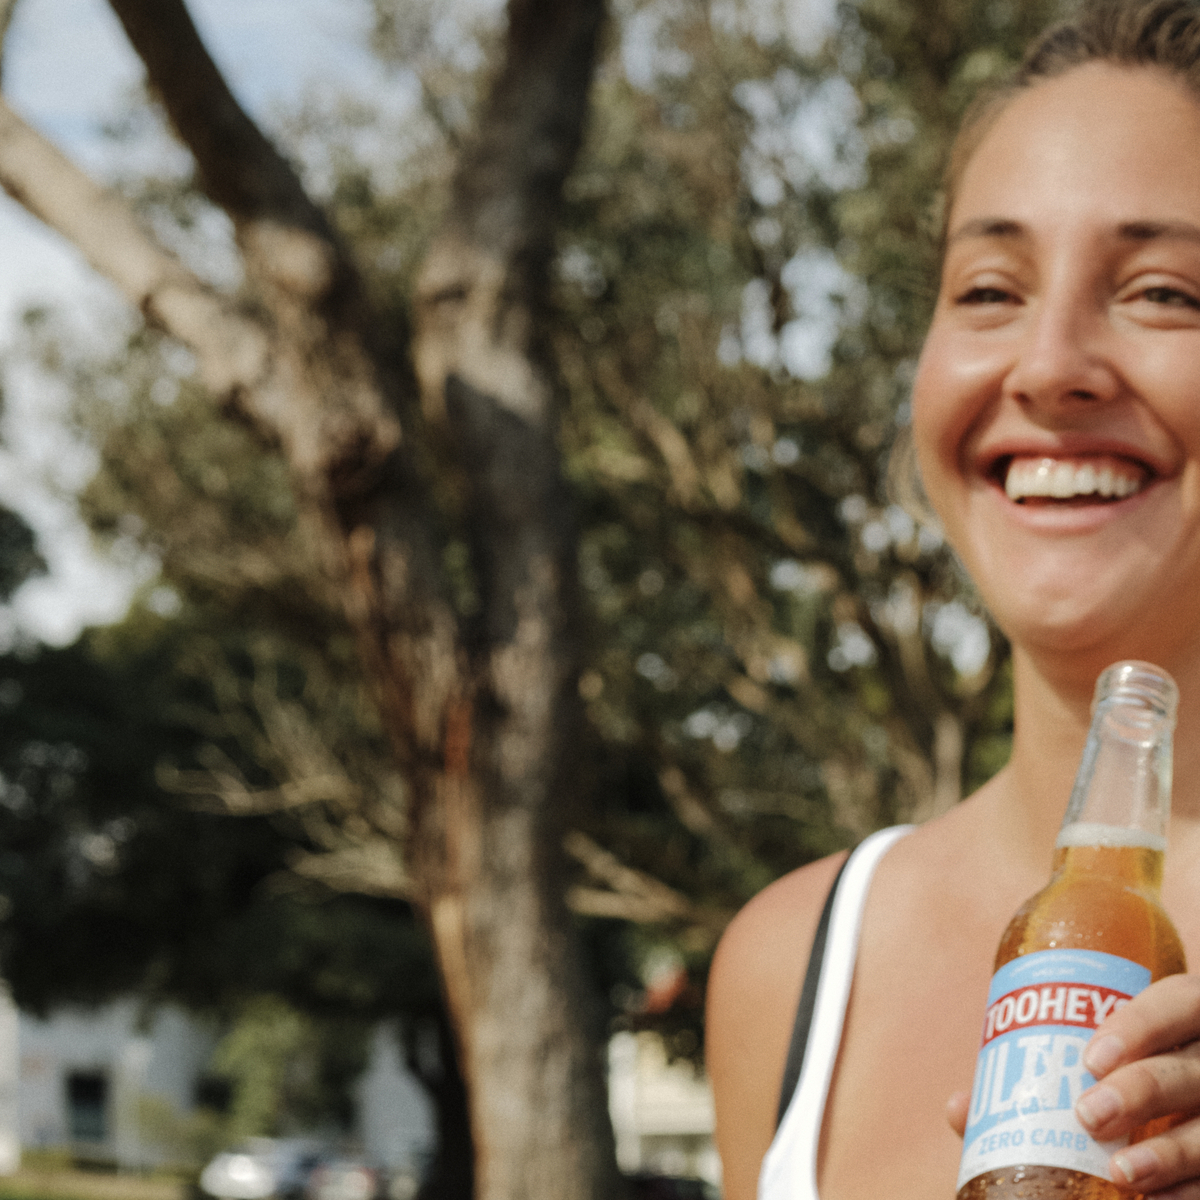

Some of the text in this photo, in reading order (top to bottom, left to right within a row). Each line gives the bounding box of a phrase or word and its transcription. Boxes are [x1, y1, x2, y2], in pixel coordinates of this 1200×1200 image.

[984, 986, 1129, 1040] TOOHEY
[967, 1033, 1091, 1129] ULTR
[978, 1128, 1023, 1156] ZERO
